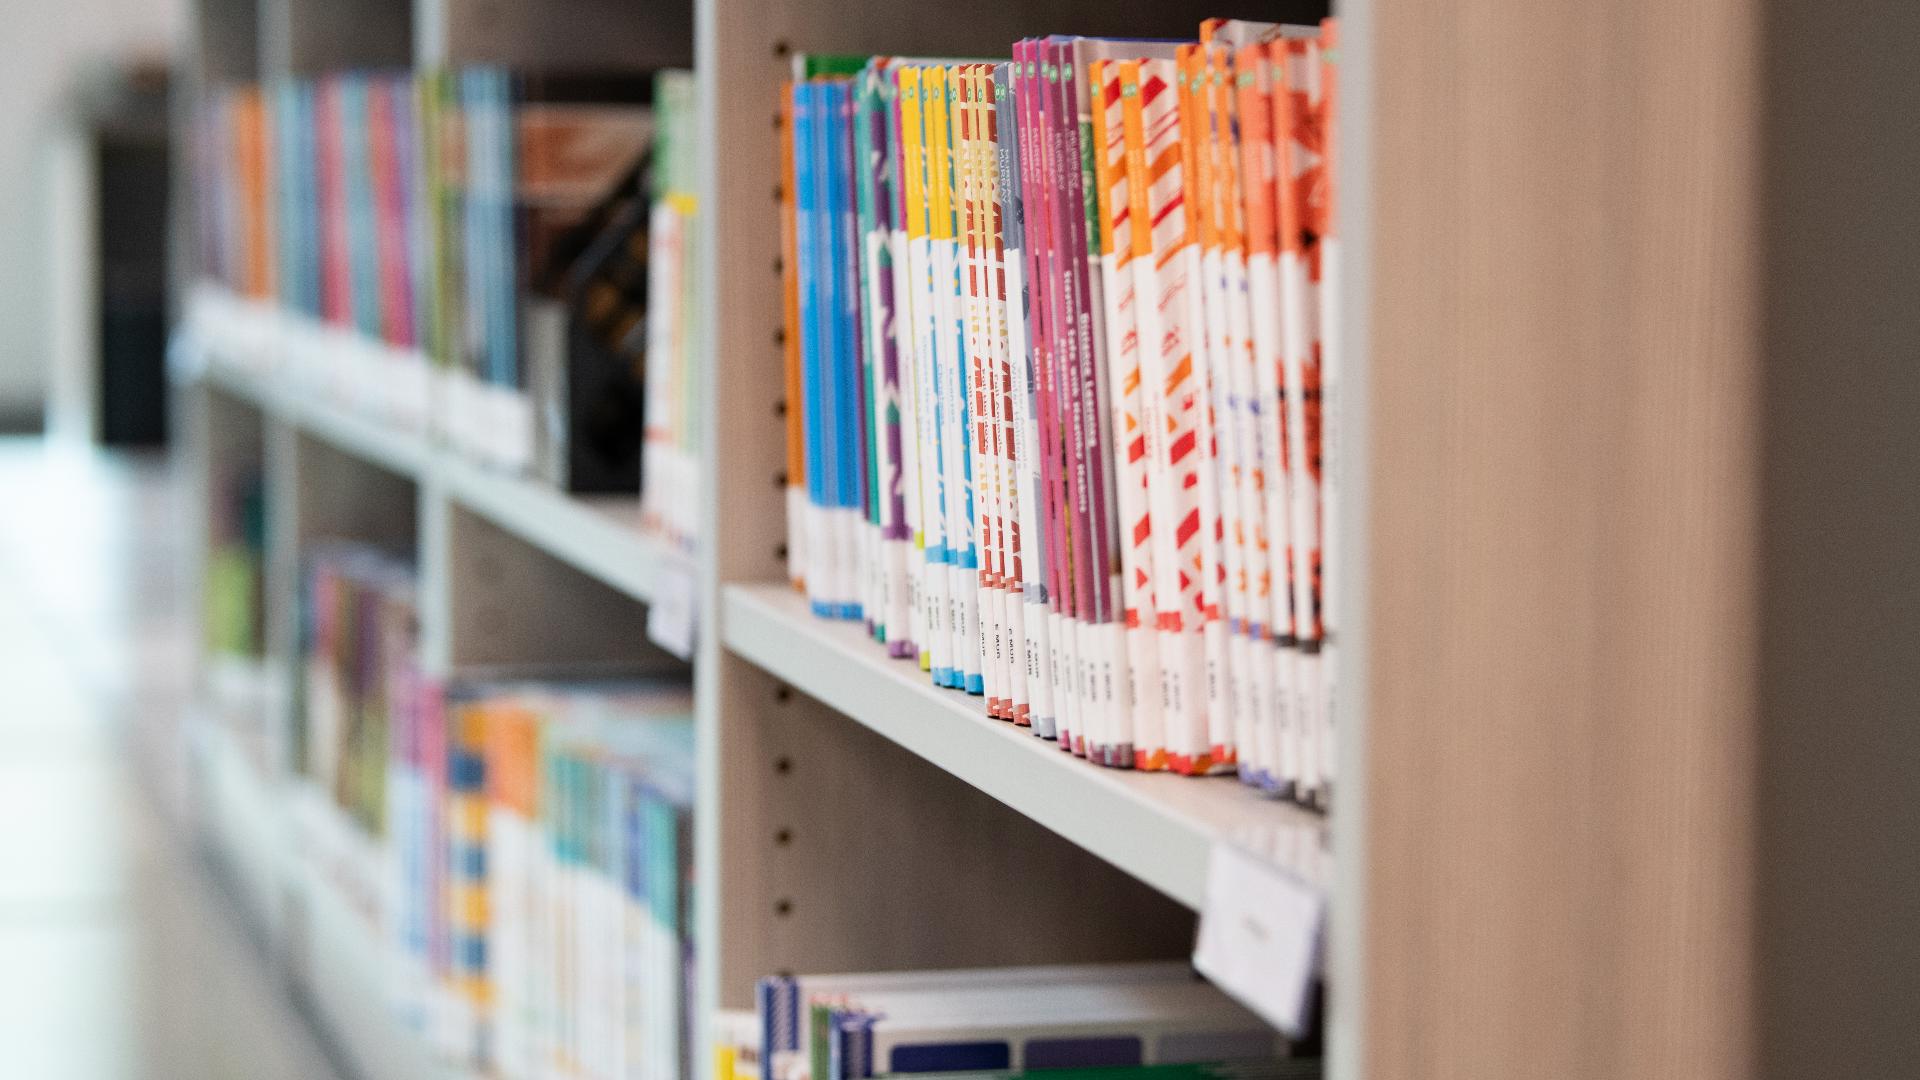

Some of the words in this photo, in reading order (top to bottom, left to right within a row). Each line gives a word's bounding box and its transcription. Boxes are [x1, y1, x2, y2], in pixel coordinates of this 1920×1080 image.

[1080, 313, 1092, 377] Distance
[1070, 366, 1079, 397] with
[1085, 381, 1097, 447] Learning
